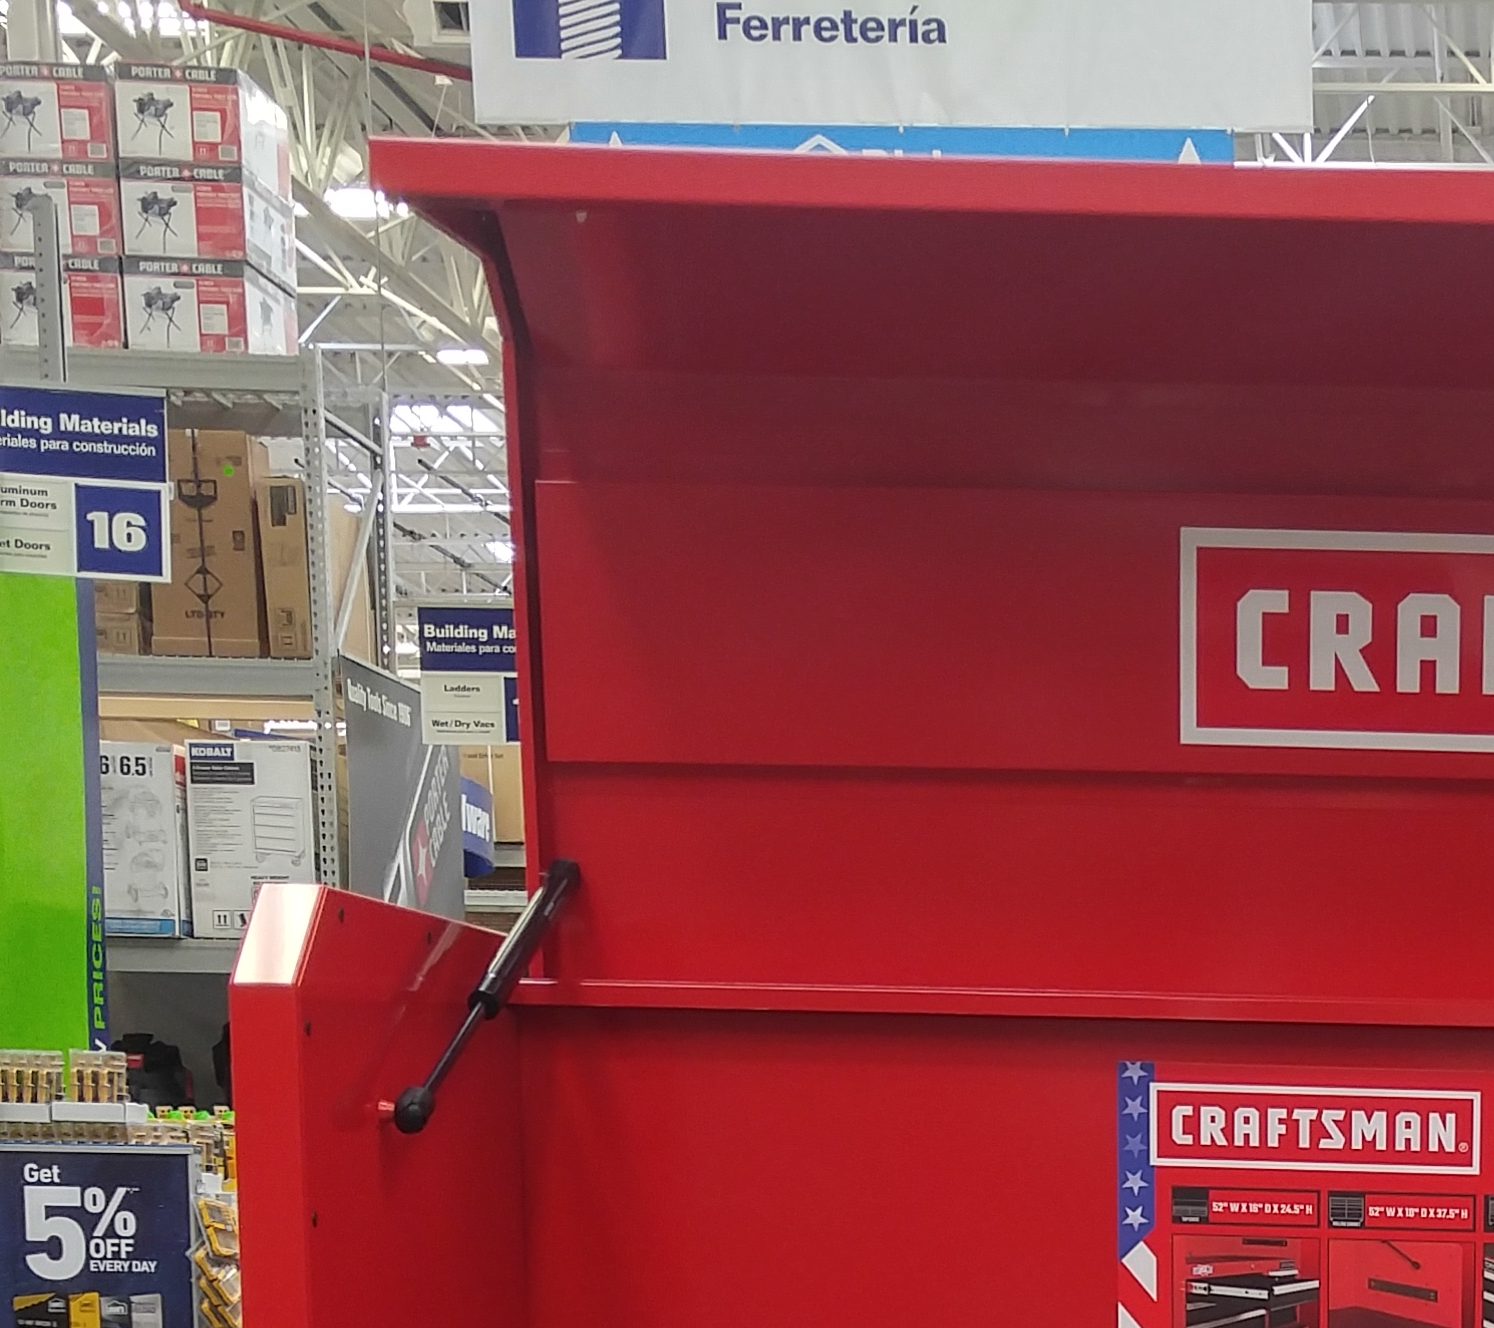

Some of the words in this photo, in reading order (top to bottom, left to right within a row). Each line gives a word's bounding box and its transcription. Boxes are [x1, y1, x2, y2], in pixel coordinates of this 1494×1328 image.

[716, 3, 948, 46] Ferretería
[0, 66, 38, 77] PORTER
[53, 68, 83, 78] CABLE
[131, 66, 170, 78] PORTER
[185, 69, 216, 81] CABLE
[9, 161, 48, 173] PORTER
[63, 163, 94, 175] CABLE
[140, 166, 179, 178] PORTER
[193, 168, 225, 180] CABLE
[68, 258, 99, 270] CABLE
[139, 261, 178, 273] PORTER
[192, 262, 222, 274] CABLE
[60, 413, 158, 437] Materials
[41, 439, 69, 452] para
[73, 442, 156, 456] construcción
[20, 498, 57, 509] Doors
[86, 511, 146, 552] 16
[15, 539, 51, 551] Doors
[423, 624, 488, 641] Building
[426, 641, 476, 653] Materiales
[479, 644, 500, 656] para
[444, 684, 480, 692] Ladders
[473, 720, 495, 728] Vacs
[191, 747, 232, 757] KOBALT
[119, 756, 148, 777] 6.5
[92, 886, 105, 1030] PRICES!
[1170, 1105, 1457, 1153] CRAFTSMAN
[23, 1163, 61, 1183] Get
[23, 1185, 137, 1281] 5%
[89, 1238, 135, 1259] OFF
[89, 1260, 131, 1272] EVERY
[132, 1260, 158, 1273] DAY
